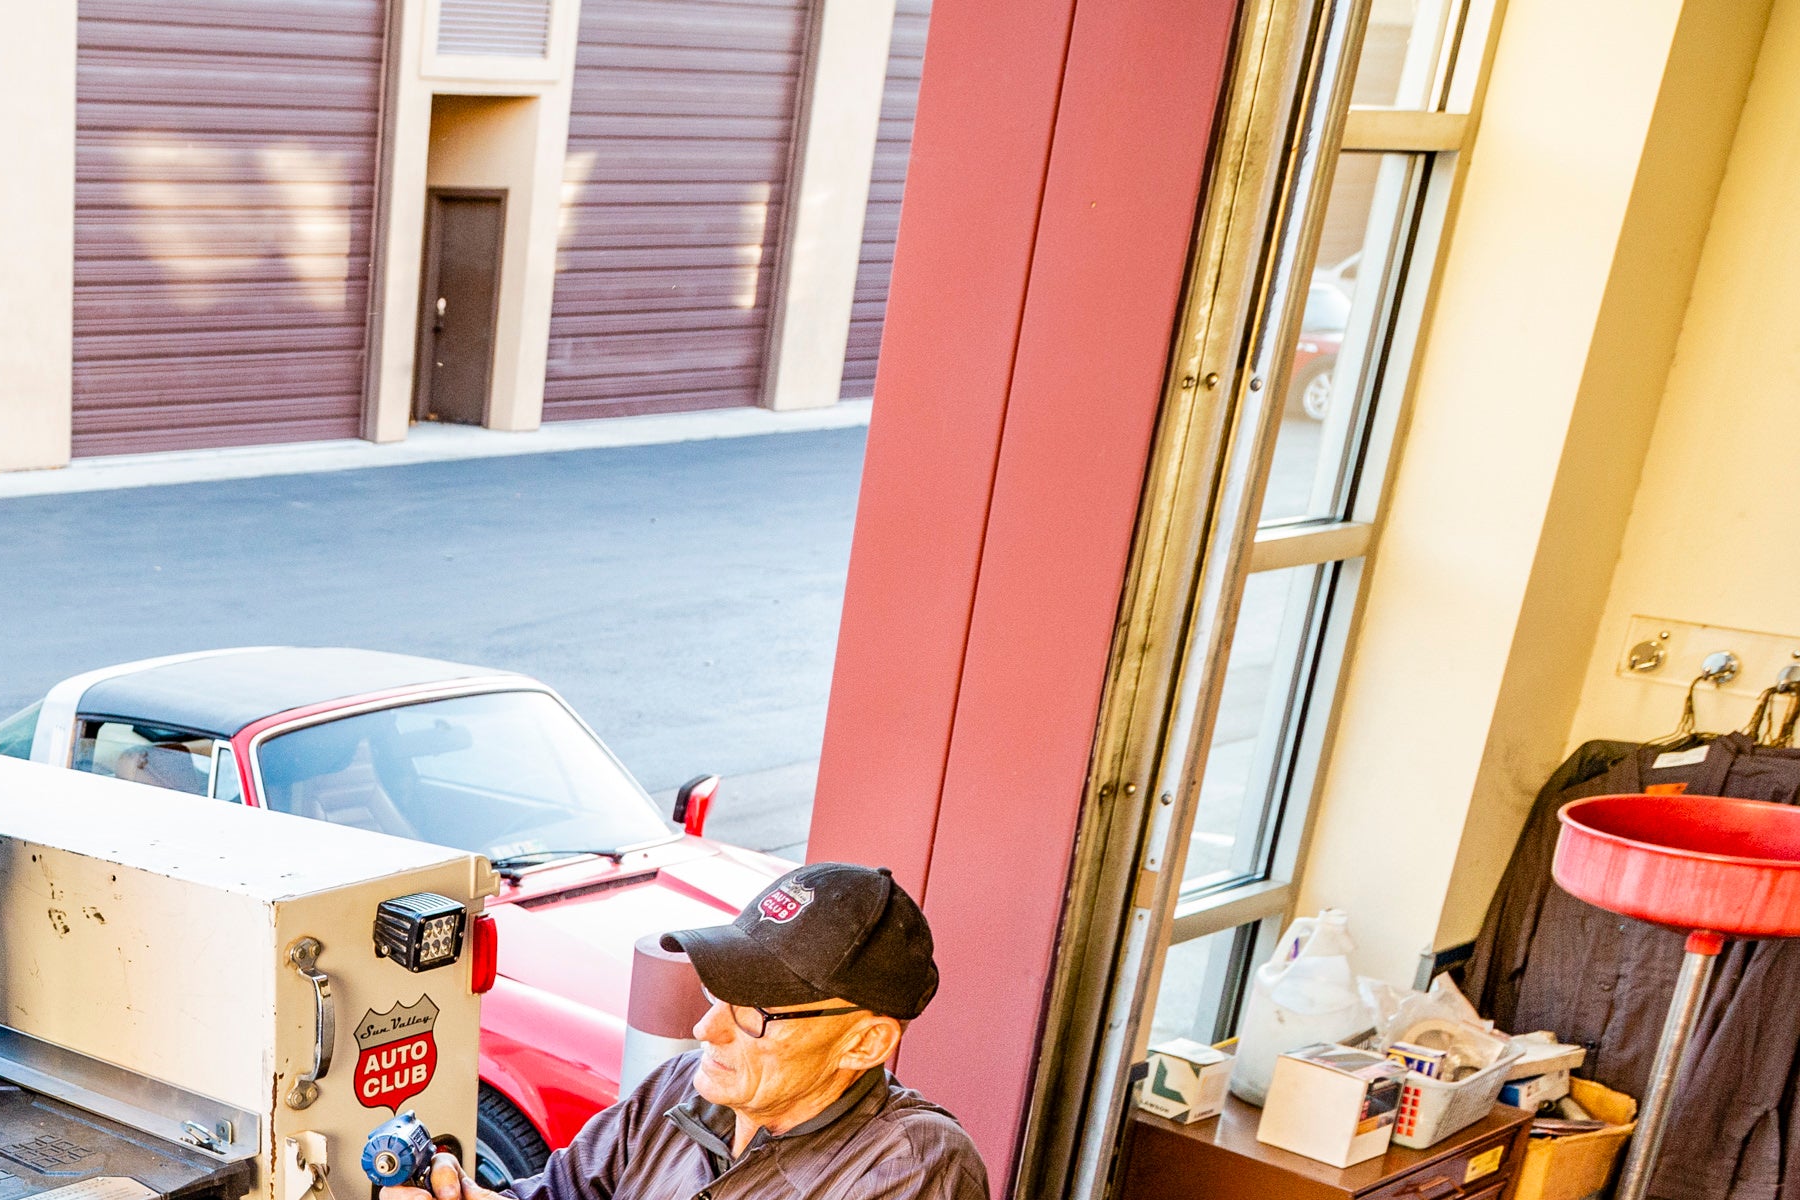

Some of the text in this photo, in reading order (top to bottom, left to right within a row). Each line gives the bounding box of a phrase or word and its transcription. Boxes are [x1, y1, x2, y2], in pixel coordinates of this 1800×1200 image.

[763, 899, 789, 919] CLUB
[771, 891, 797, 911] AUTO
[360, 1015, 433, 1040] Sun Valley
[363, 1040, 428, 1075] AUTO
[363, 1063, 428, 1098] CLUB
